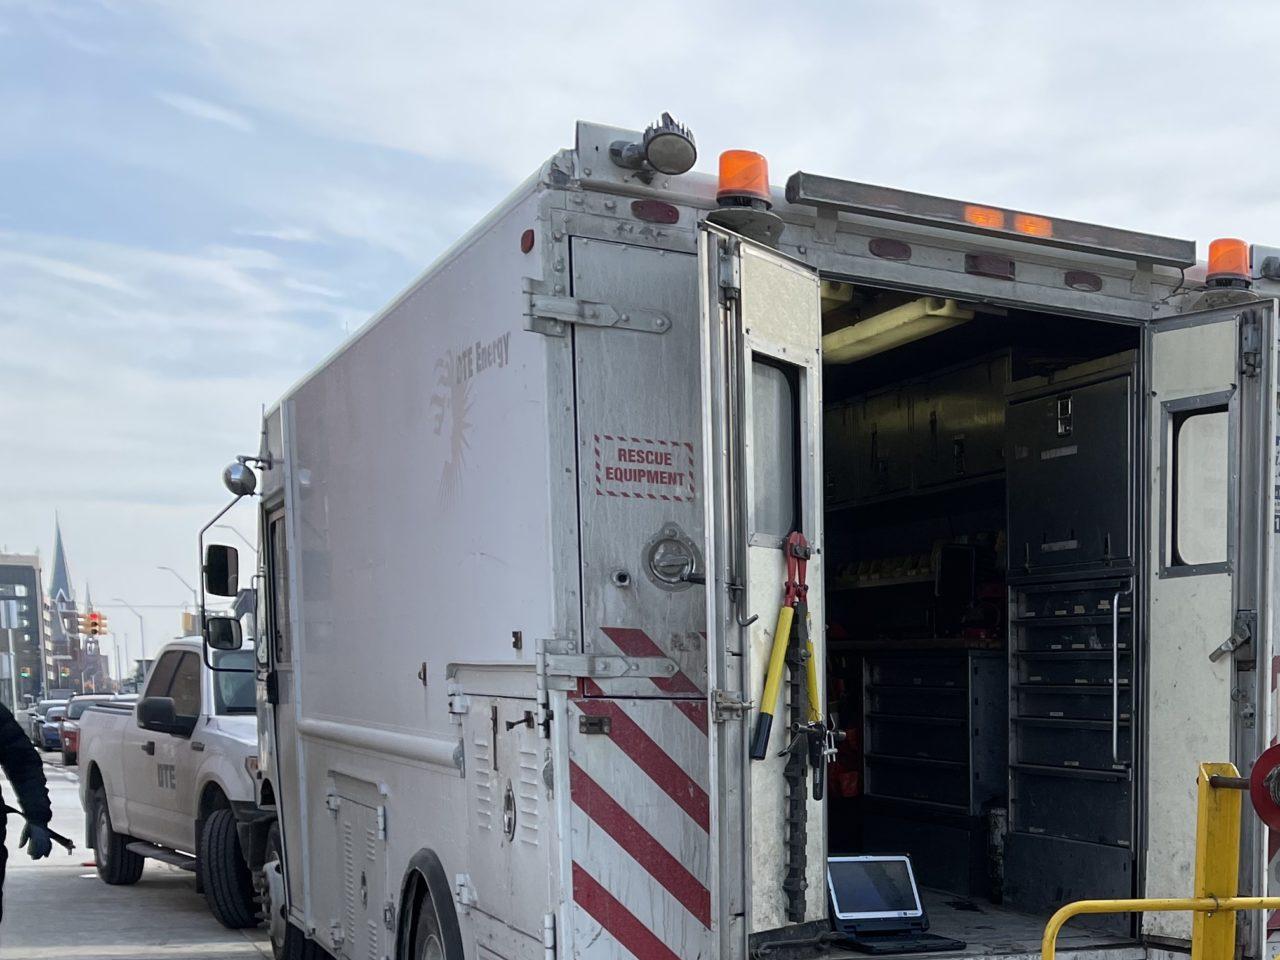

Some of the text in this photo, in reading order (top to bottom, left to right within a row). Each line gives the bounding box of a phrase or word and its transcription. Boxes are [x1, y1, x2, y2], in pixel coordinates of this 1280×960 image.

[475, 331, 511, 373] Energy
[617, 448, 672, 466] RESCUE
[605, 466, 685, 486] EQUIPMENT
